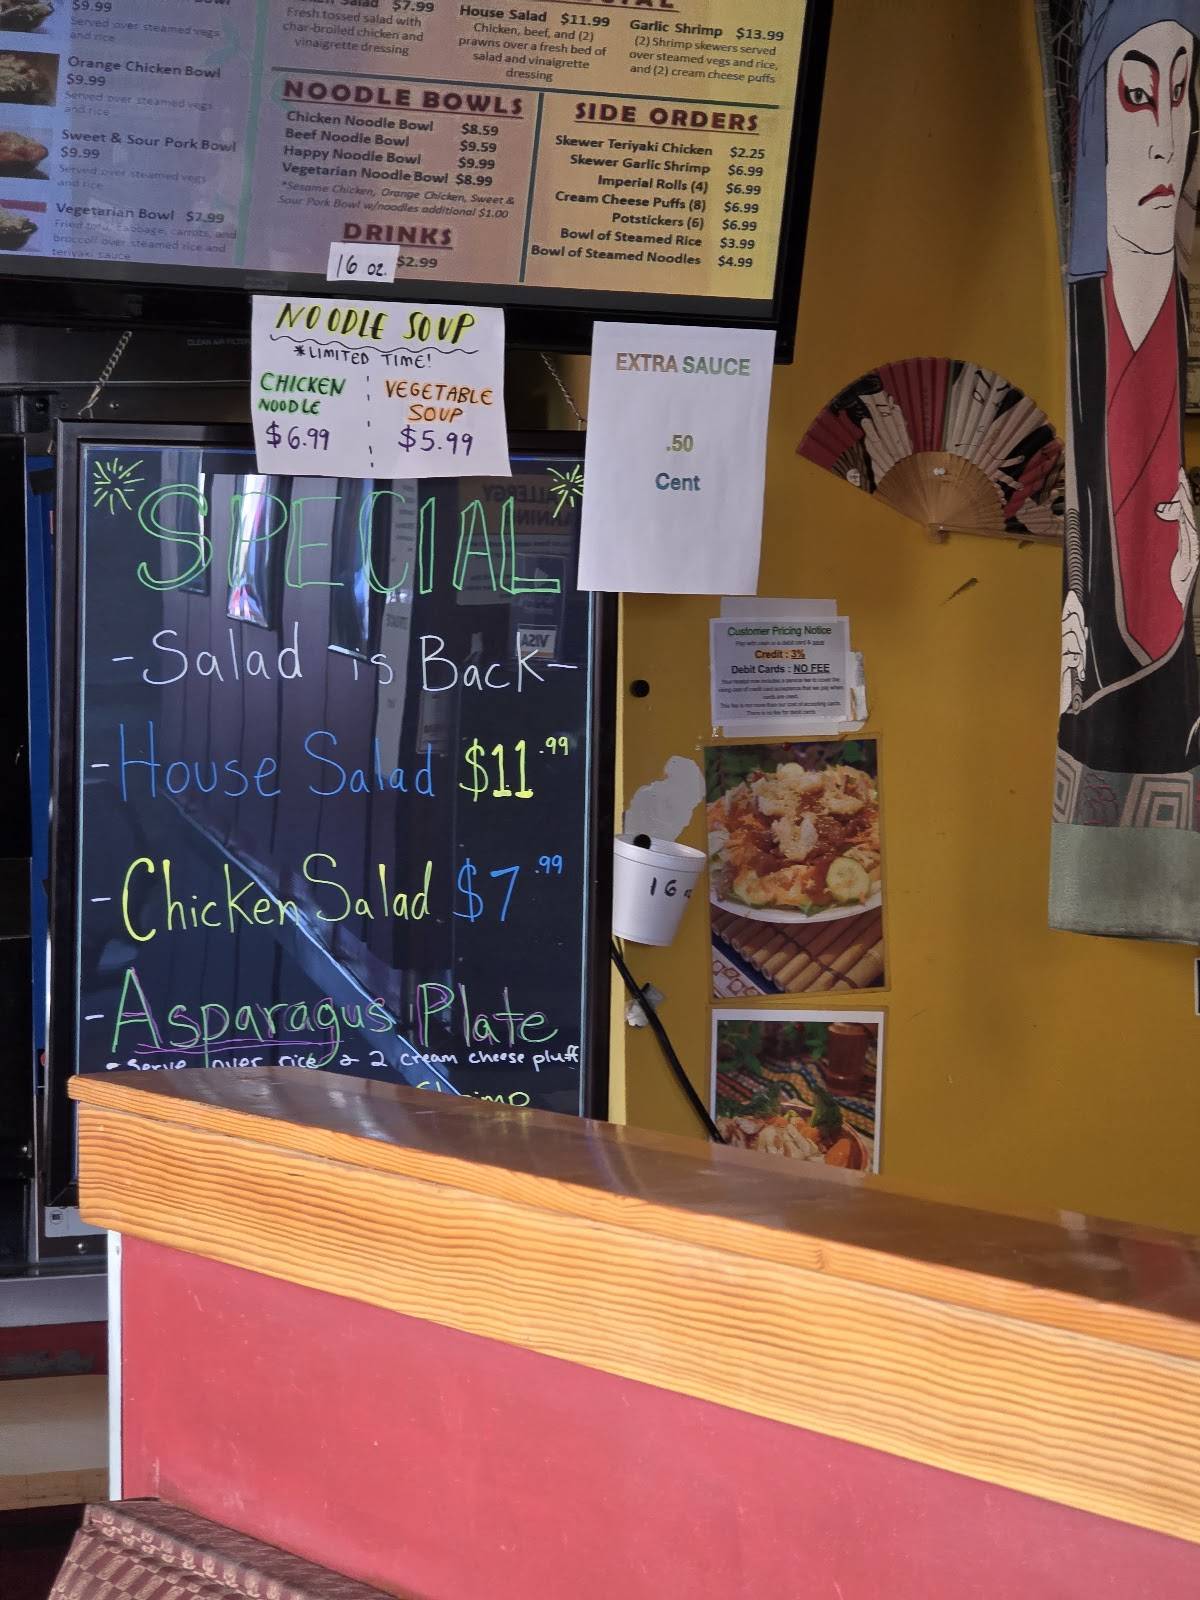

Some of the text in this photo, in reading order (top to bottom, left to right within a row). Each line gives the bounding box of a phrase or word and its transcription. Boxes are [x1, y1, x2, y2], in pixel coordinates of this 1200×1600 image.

[392, 0, 434, 13] $7.99
[362, 14, 421, 27] salad with
[509, 9, 547, 22] Salad
[561, 13, 610, 27] $11.99
[357, 27, 423, 41] chicken and
[554, 30, 575, 39] and
[578, 31, 594, 42] (2)
[630, 19, 784, 42] Garlic Shrimp $13.99
[361, 43, 409, 57] dressing
[459, 36, 607, 56] prawns over fresh bed of
[635, 36, 776, 56] (2) Shrimp skewers served
[68, 56, 221, 79] Orange Chicken Bowl
[473, 52, 589, 69] salad and vinaigrette
[629, 51, 654, 60] over
[657, 51, 704, 65] steamed
[706, 58, 730, 68] vegs
[733, 58, 752, 68] and
[67, 74, 105, 86] $9.99
[506, 68, 553, 82] dressing
[630, 65, 776, 84] and (2) cream cheese puffs
[284, 80, 523, 115] NOODLE BOWLS
[287, 111, 498, 136] Chicken Noodle Bowl $8.59
[576, 102, 758, 131] SIDE ORDERS
[62, 129, 105, 143] Sweet
[127, 134, 159, 147] Sour
[165, 137, 198, 149] Pork
[201, 140, 236, 152] Bowl
[286, 128, 497, 153] Beef Noodle Bowl $9.59
[556, 135, 765, 159] Skewer Teriyaki Chicken $2.25
[60, 147, 100, 159] $9.99
[284, 145, 495, 169] Happy Noodle Bowl $9.99
[282, 162, 492, 187] Vegetarian Noodle Bowl $8.99
[570, 155, 763, 177] Skewer Garlic Shrimp $6.99
[598, 175, 761, 196] Imperial Rolls (4) $6.99
[421, 204, 509, 219] additional $1.00
[555, 191, 759, 214] Cream Cheese Puffs (8) $6.99
[56, 203, 224, 224] Vegetarian Bowl $7.99
[612, 213, 757, 232] Potstickers (6) $6.99
[343, 223, 453, 246] DRINKS
[560, 228, 755, 250] Bowl of Steamed Rice $3.99
[337, 254, 357, 278] 16
[397, 255, 437, 269] $2.99
[531, 245, 753, 268] Bowl of Steamed Noodles $4.99
[275, 303, 475, 344] NOODLE SOUP
[381, 353, 432, 369] TIME!
[616, 353, 750, 376] EXTRA SAUCE
[260, 372, 346, 395] CHICKEN
[385, 380, 493, 405] VEGETABLE
[258, 399, 321, 415] NOODLE
[408, 404, 464, 423] SOUP
[265, 421, 330, 450] $6.99
[398, 425, 473, 456] $5.99
[666, 435, 694, 452] .50
[655, 473, 701, 491] Cent
[137, 483, 561, 595] SPECIAL
[727, 626, 832, 636] Customer Pricing Notice
[354, 645, 393, 685] is
[755, 650, 805, 659] Credit 3%
[731, 664, 830, 674] Debit Cards NO FEE
[304, 730, 435, 798] Salad
[303, 853, 433, 922] Salad
[416, 982, 559, 1047] Plate
[278, 1054, 319, 1069] rice
[369, 1052, 387, 1067] 2
[400, 1052, 458, 1066] cream
[469, 1050, 524, 1063] cheese
